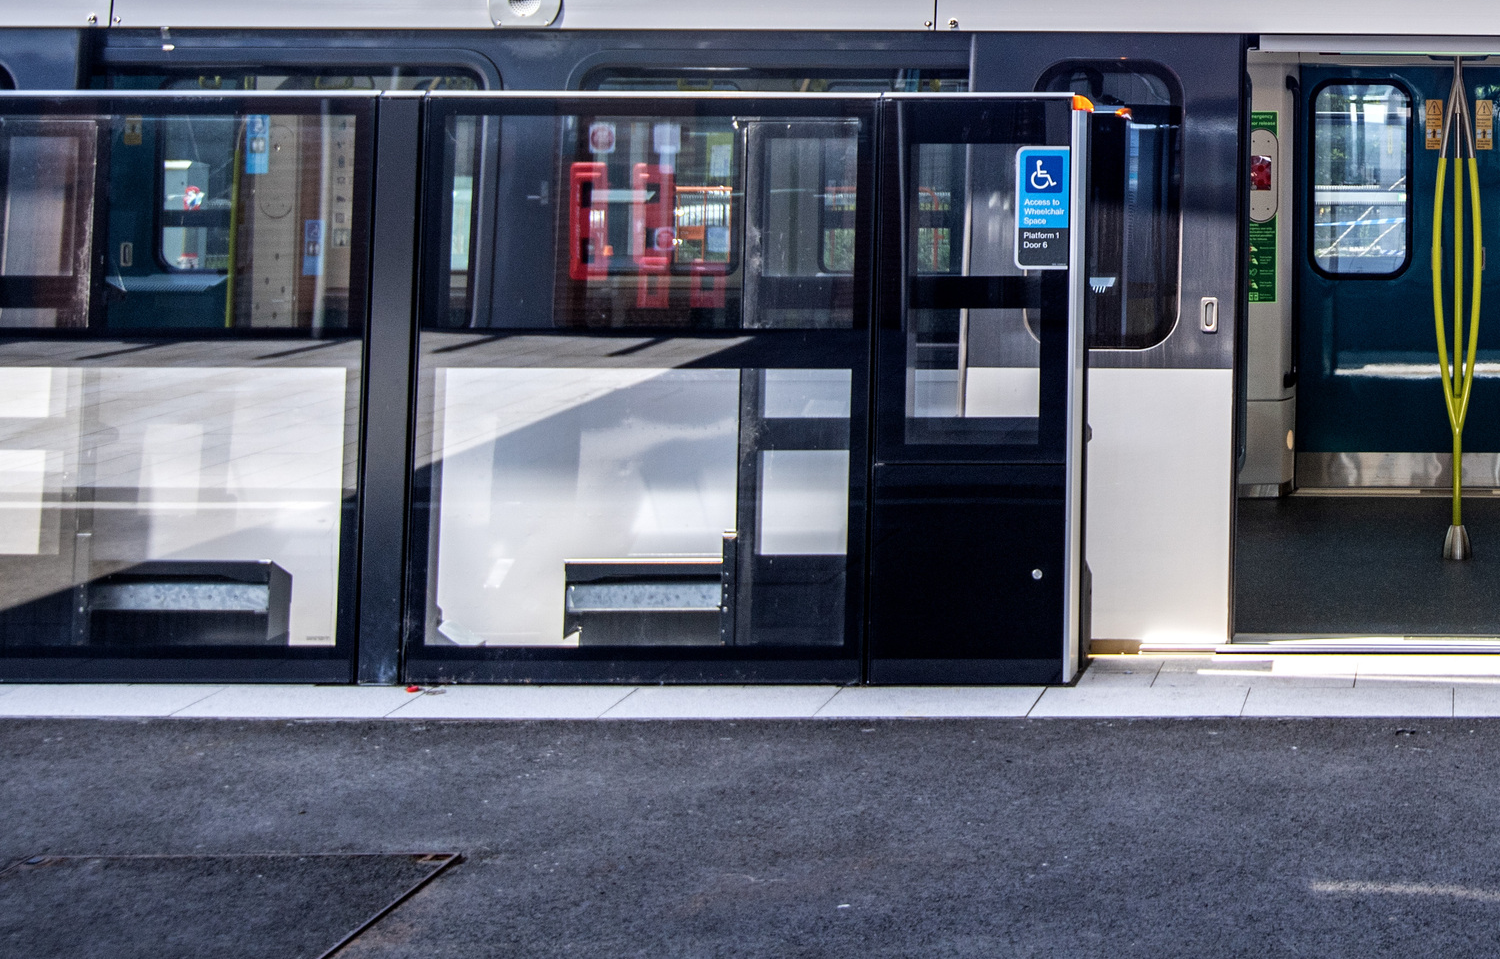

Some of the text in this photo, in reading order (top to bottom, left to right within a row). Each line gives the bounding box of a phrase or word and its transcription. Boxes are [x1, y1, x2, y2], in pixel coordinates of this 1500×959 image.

[1023, 198, 1061, 206] Access to
[1023, 207, 1065, 216] Wheelchair
[1023, 216, 1047, 225] Space
[1023, 231, 1060, 239] Platform 1
[1023, 241, 1049, 249] Door 6
